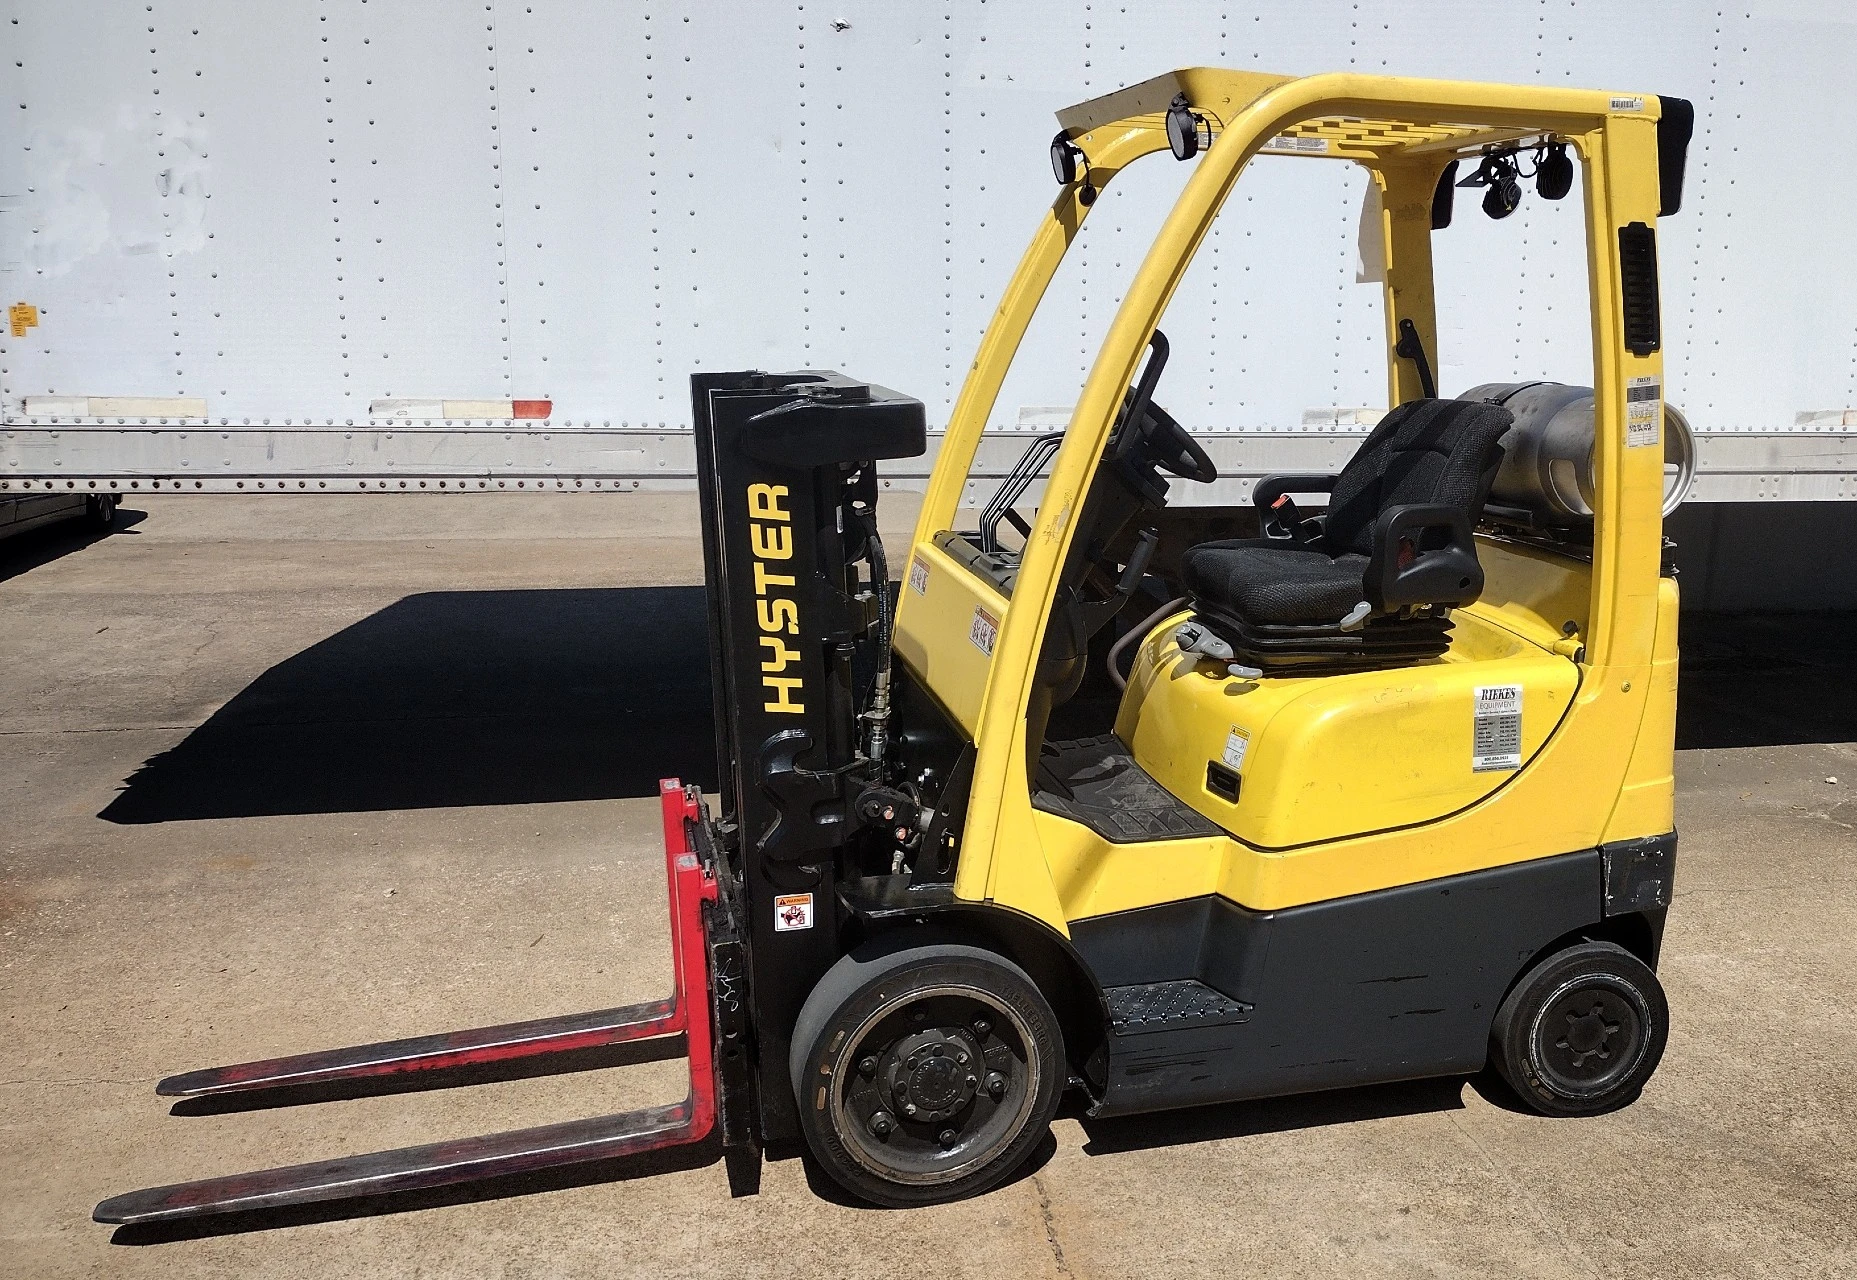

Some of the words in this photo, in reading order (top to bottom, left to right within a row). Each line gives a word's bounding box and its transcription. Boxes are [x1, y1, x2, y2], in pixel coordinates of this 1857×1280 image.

[747, 483, 804, 714] HYSTER
[1479, 701, 1516, 709] EQUIPMENT
[1481, 687, 1516, 700] RIEKES
[1000, 986, 1048, 1046] TRELLEBORG
